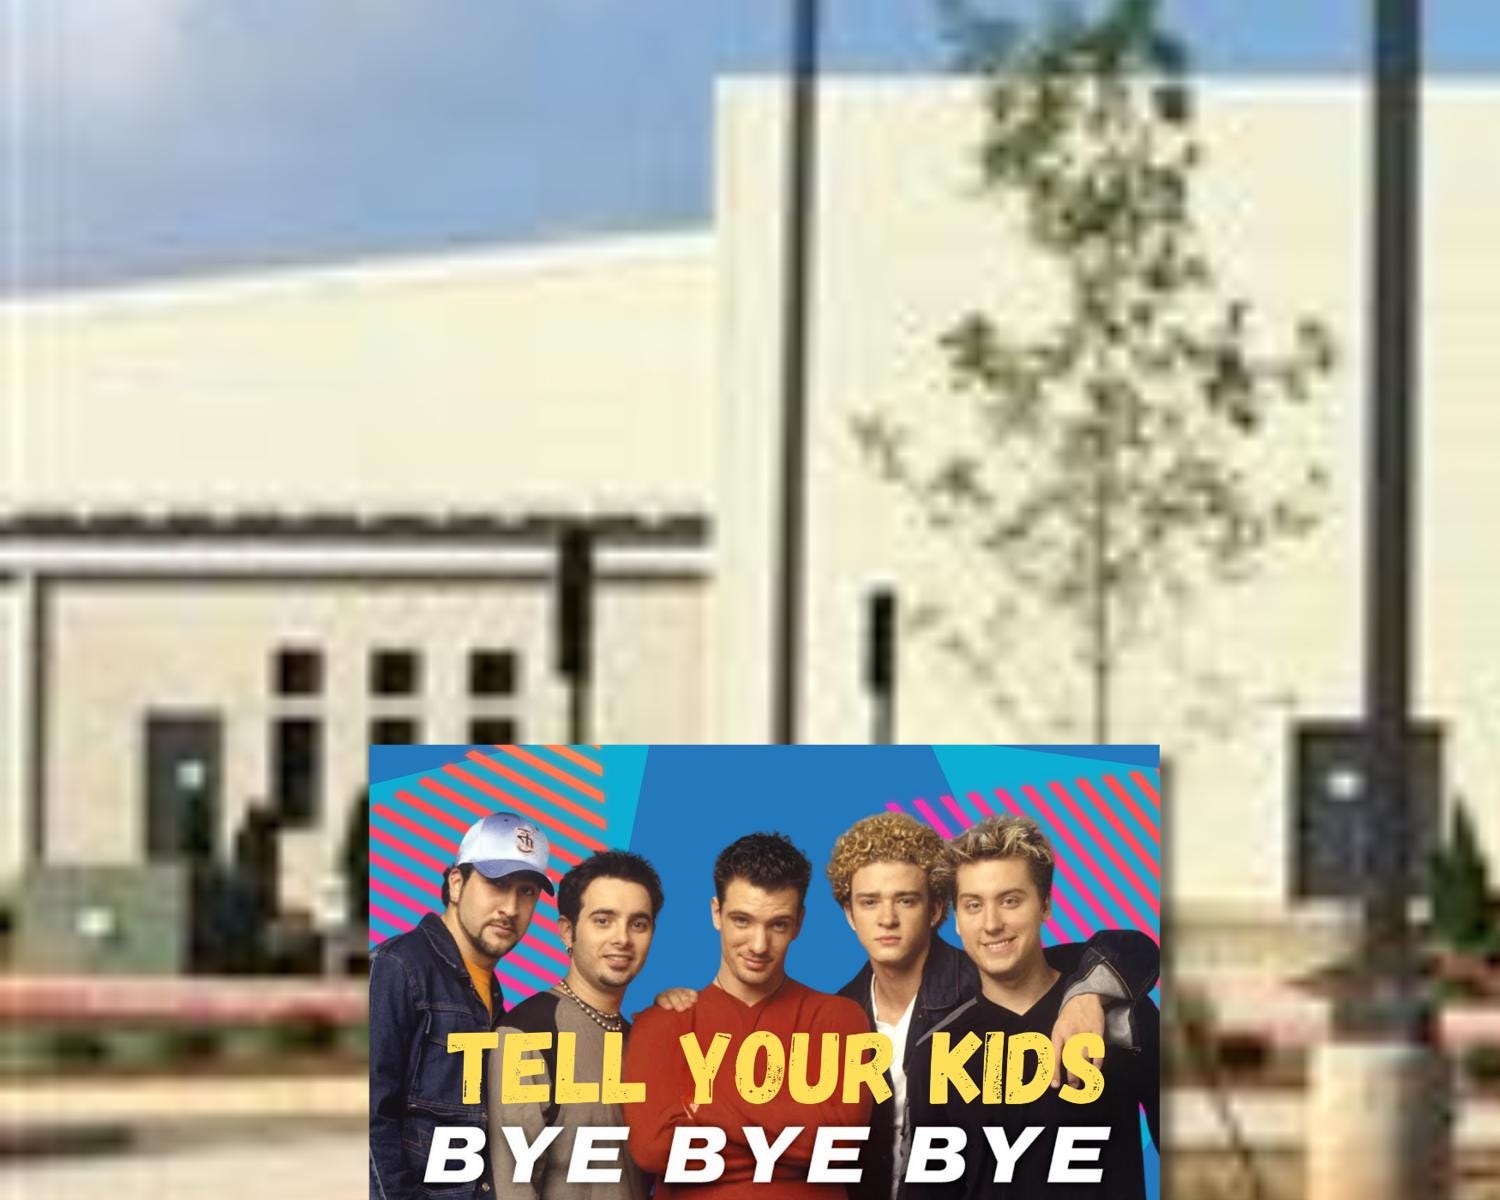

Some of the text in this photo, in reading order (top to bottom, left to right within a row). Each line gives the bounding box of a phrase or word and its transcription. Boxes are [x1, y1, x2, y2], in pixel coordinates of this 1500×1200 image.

[447, 1031, 1106, 1105] TELL YOUR KIDS
[423, 1126, 1112, 1184] BYE BYE BYE
